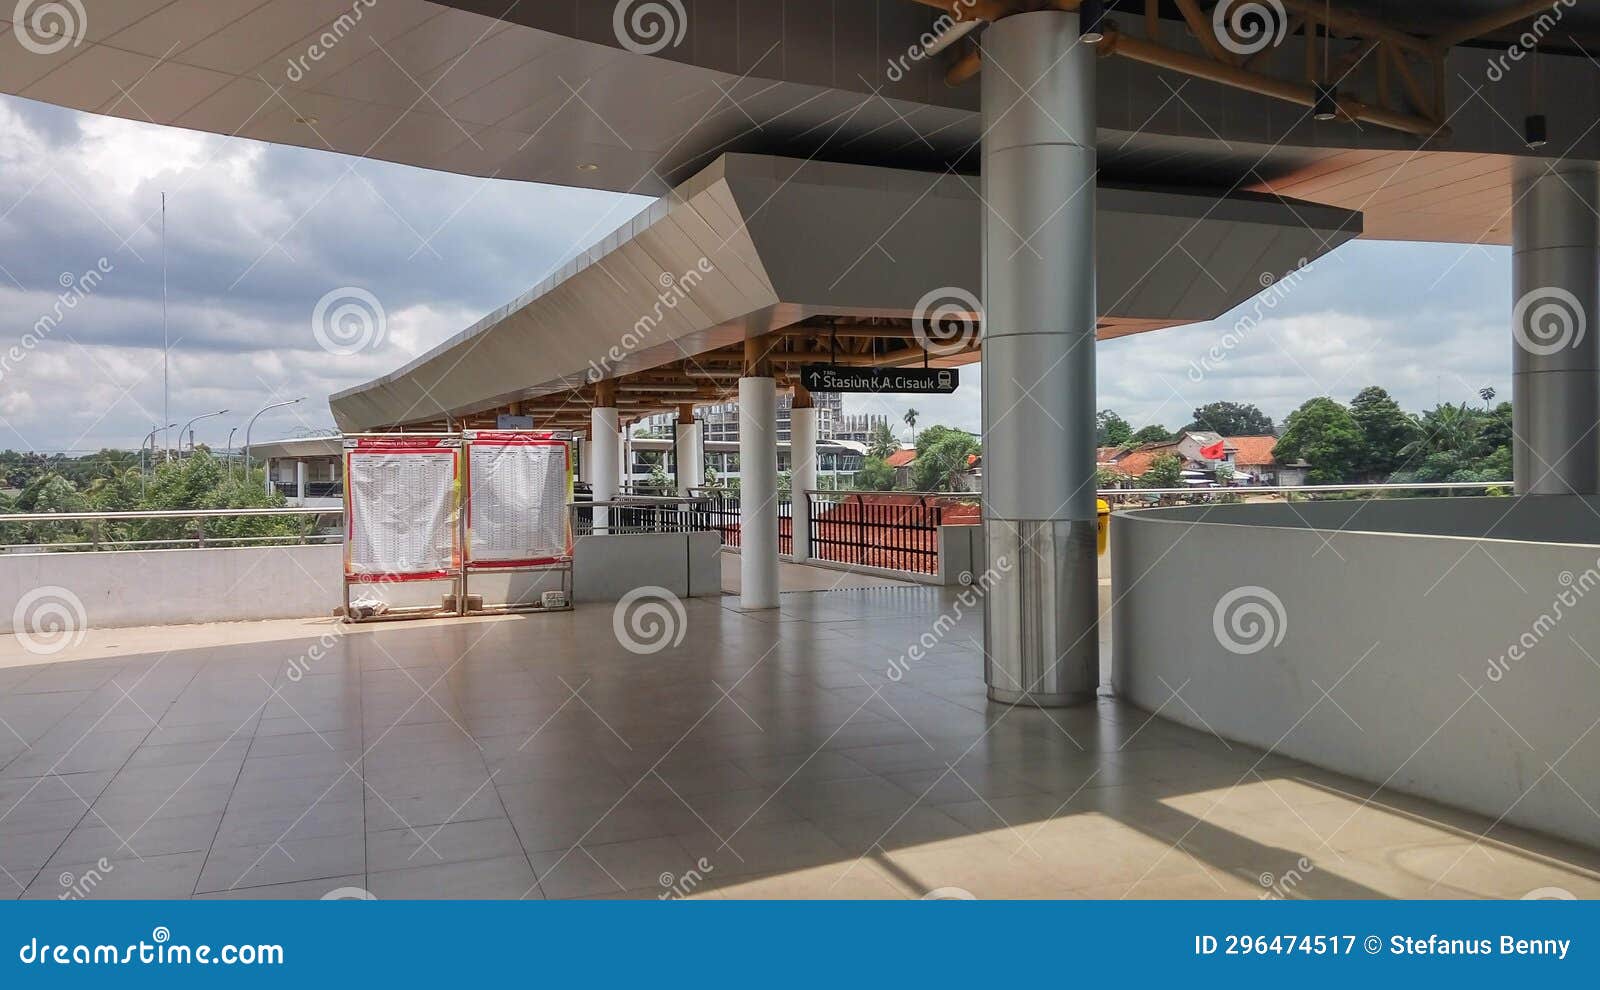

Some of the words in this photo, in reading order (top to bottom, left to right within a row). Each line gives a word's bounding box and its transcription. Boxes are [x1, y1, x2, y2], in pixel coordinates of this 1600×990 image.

[823, 375, 869, 389] Stasiun
[871, 376, 894, 389] K.A.
[895, 376, 935, 389] Cisauk
